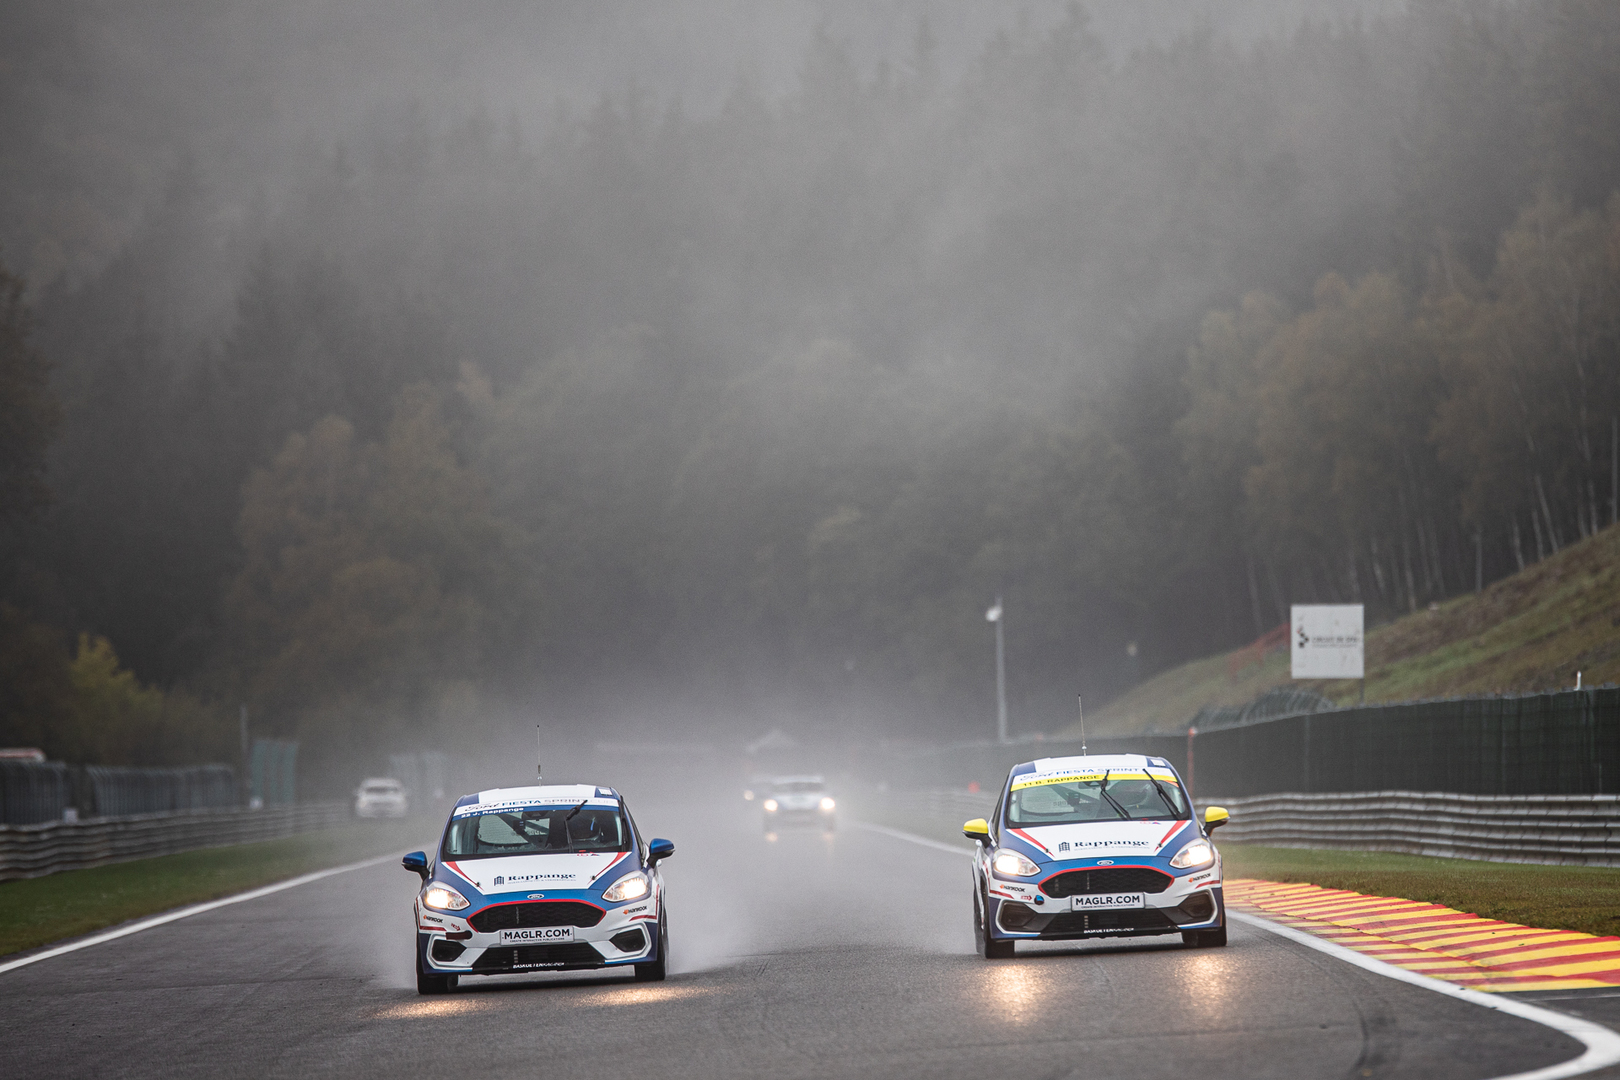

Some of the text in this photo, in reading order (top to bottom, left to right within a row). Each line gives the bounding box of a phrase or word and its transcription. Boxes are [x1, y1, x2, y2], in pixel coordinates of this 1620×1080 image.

[502, 797, 541, 806] FIESTA
[482, 807, 524, 815] Rappange
[1075, 895, 1140, 906] MAGLR.COM
[504, 928, 570, 940] MAGLR.COM
